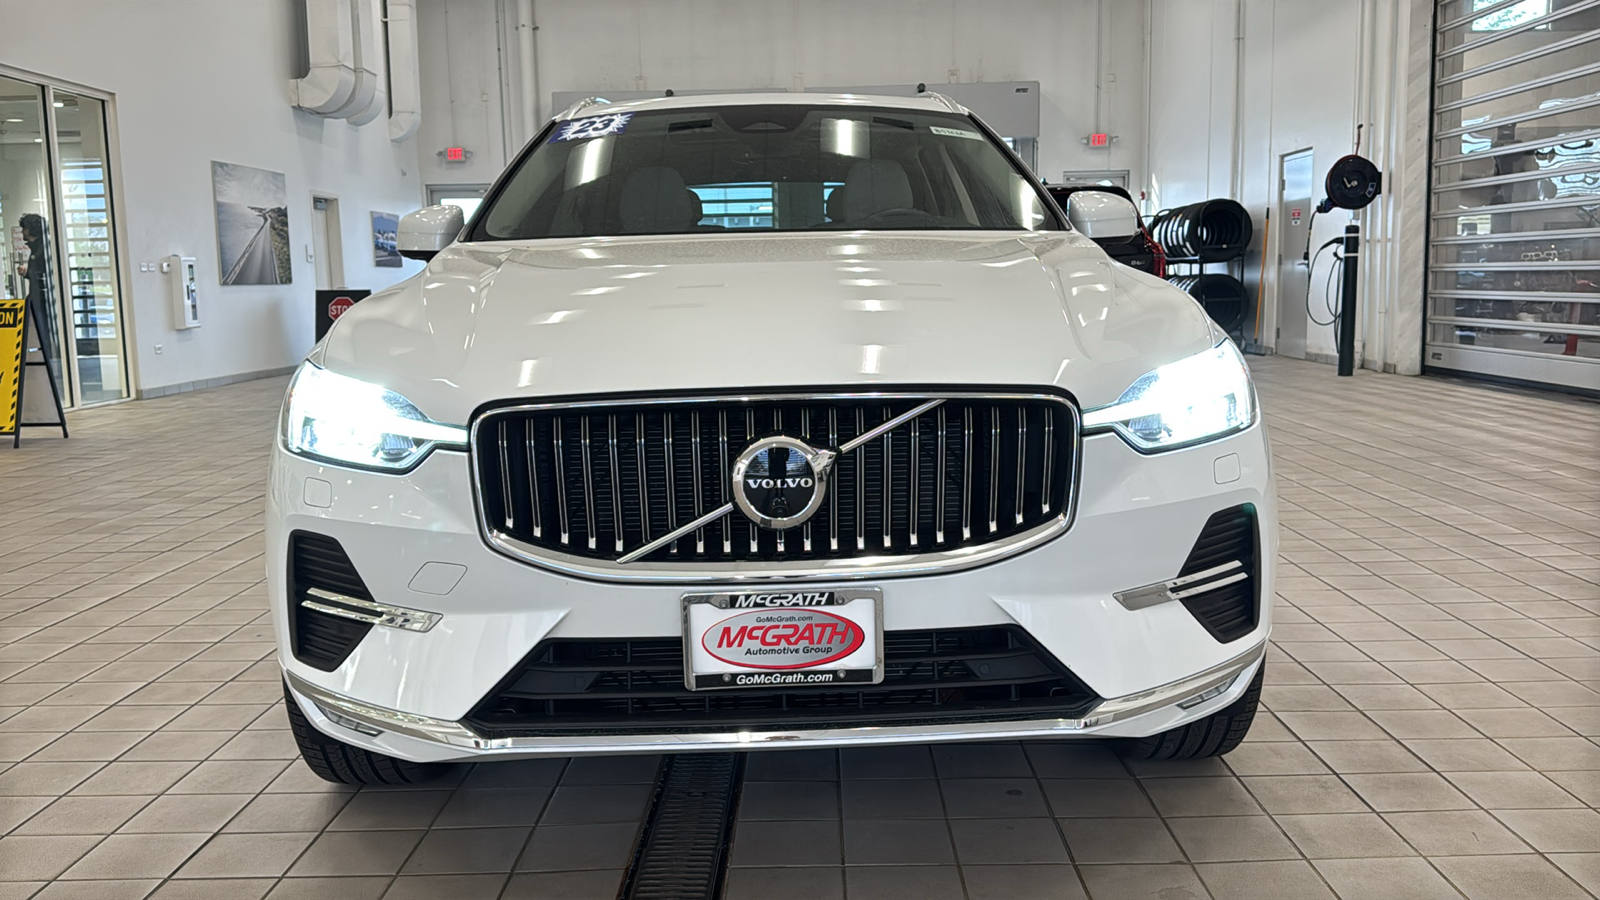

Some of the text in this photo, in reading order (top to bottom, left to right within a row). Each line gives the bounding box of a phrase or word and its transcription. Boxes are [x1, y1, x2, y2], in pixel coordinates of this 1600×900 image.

[571, 118, 615, 135] 23
[331, 305, 348, 315] STO
[747, 478, 813, 489] VOLVO
[755, 615, 813, 623] GoMcGrath.com
[745, 646, 833, 656] Automotive Group
[736, 672, 833, 685] GoMcGrath.com
